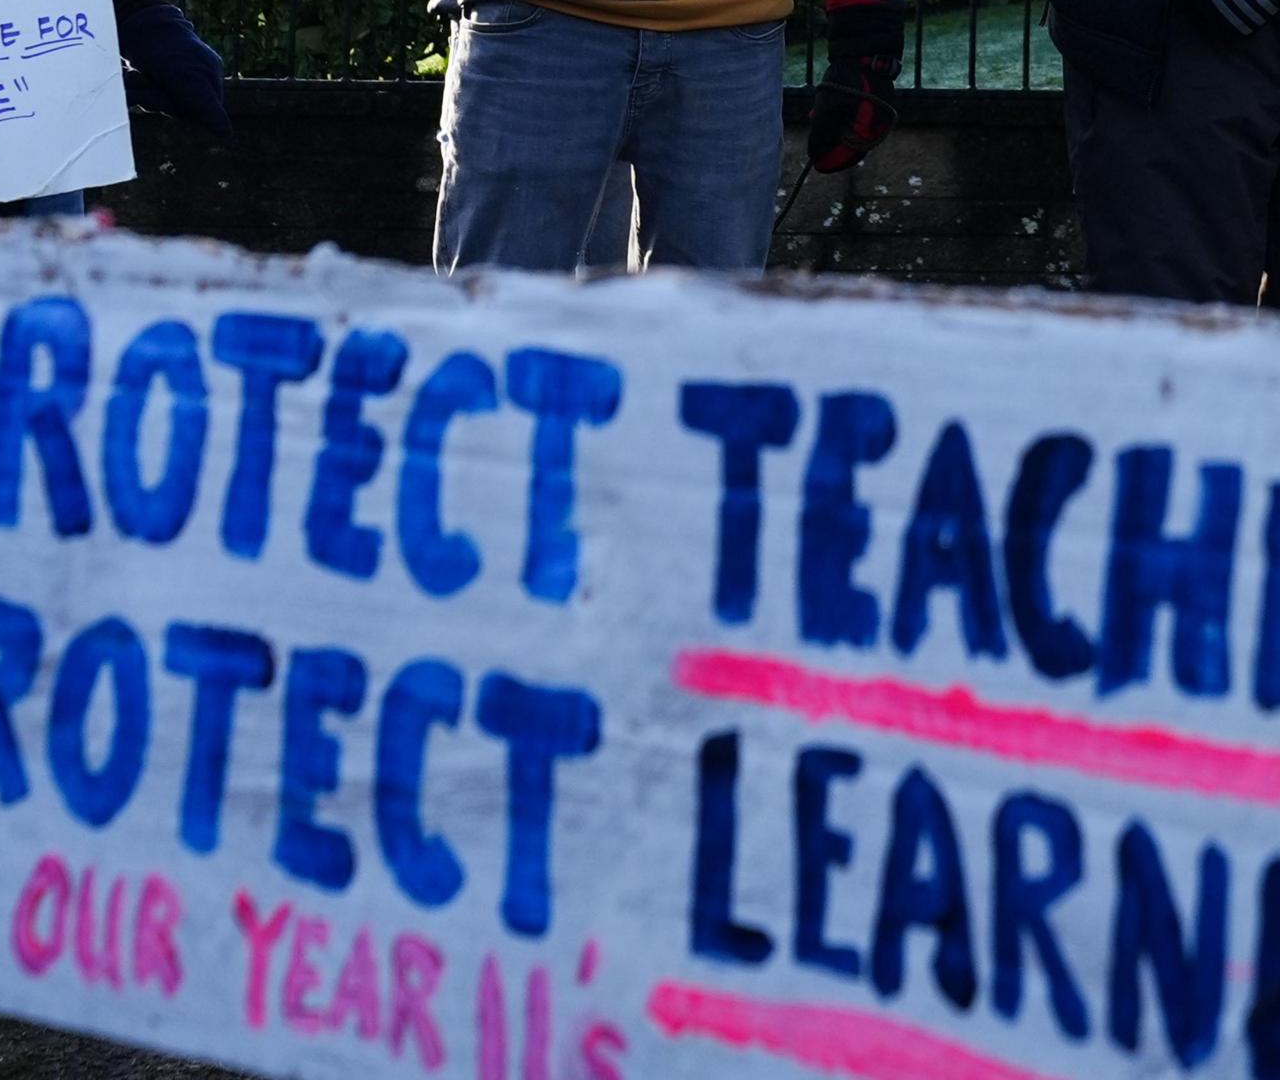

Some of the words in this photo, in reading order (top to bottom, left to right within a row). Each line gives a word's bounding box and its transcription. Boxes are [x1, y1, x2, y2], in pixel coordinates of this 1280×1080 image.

[37, 12, 95, 41] FOR
[10, 852, 184, 998] OUR
[232, 886, 446, 1070] YEAR
